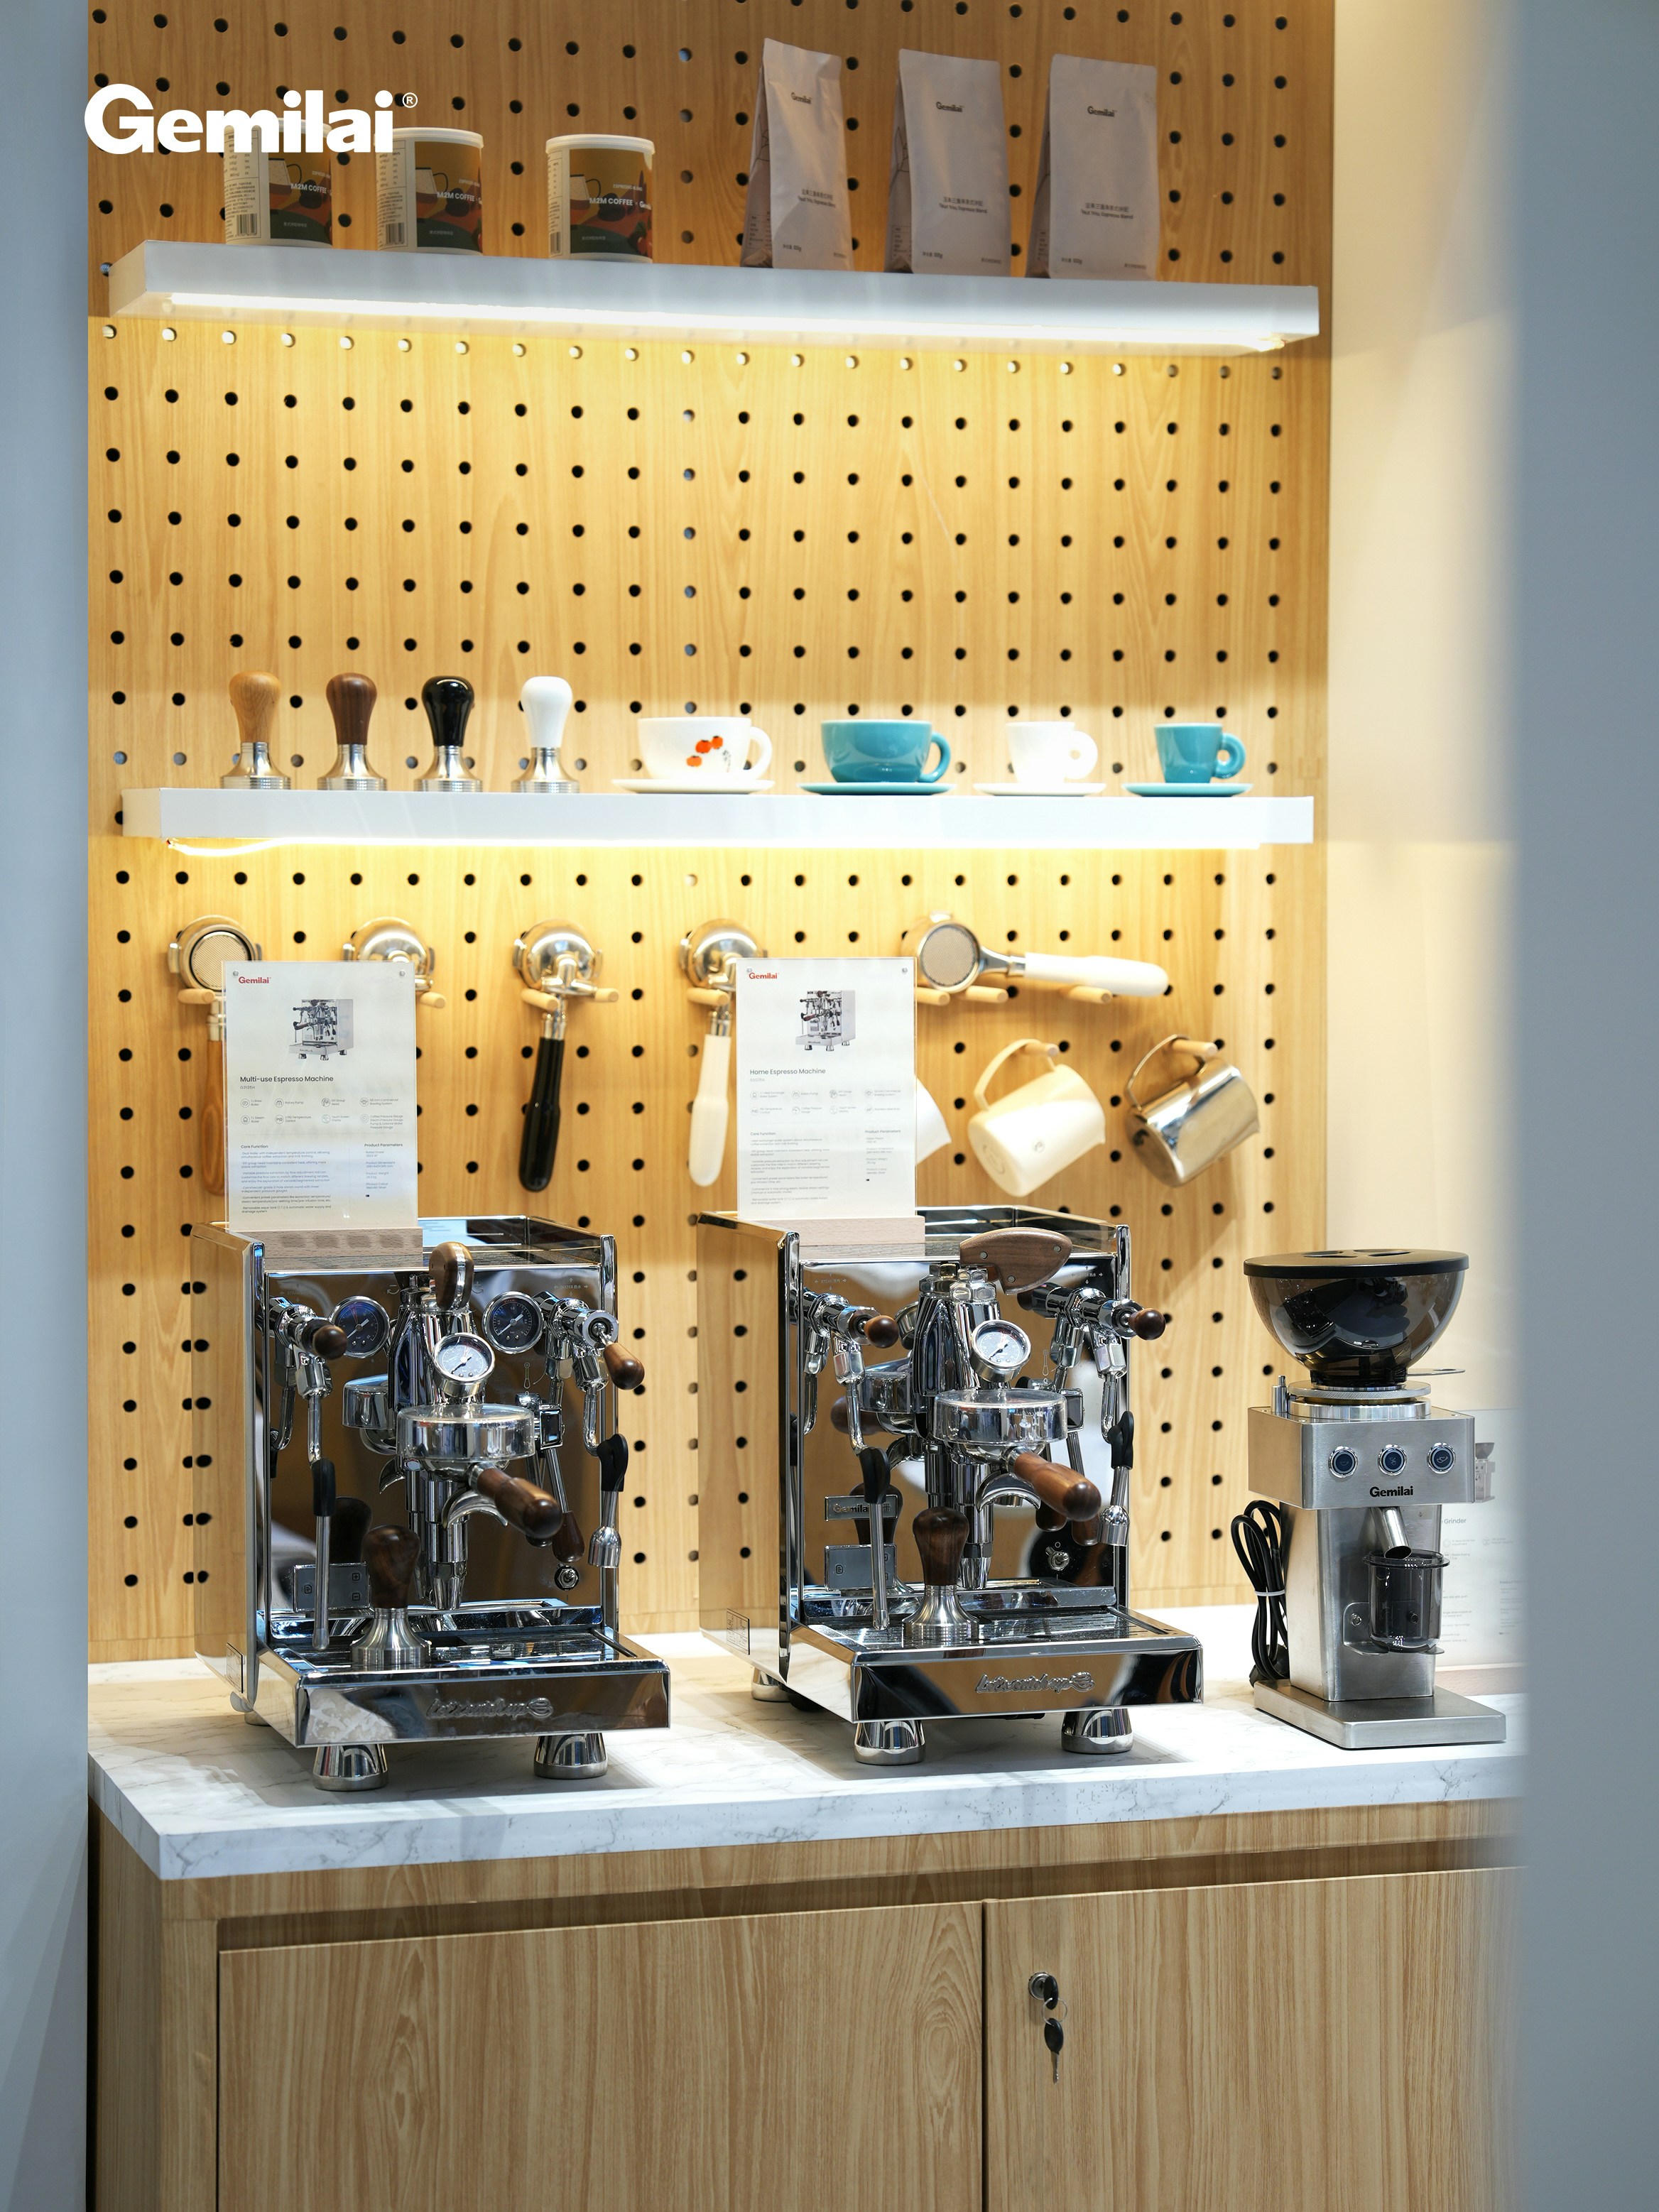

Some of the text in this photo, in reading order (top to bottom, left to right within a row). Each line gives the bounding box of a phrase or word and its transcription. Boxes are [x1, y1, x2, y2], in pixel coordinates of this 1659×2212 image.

[790, 92, 812, 104] Gemilai
[936, 102, 963, 113] Gemilai
[1087, 106, 1115, 117] Gemilai
[308, 184, 327, 194] COFFEE
[455, 192, 475, 202] COFFEE
[1369, 1486, 1414, 1498] Gemilai
